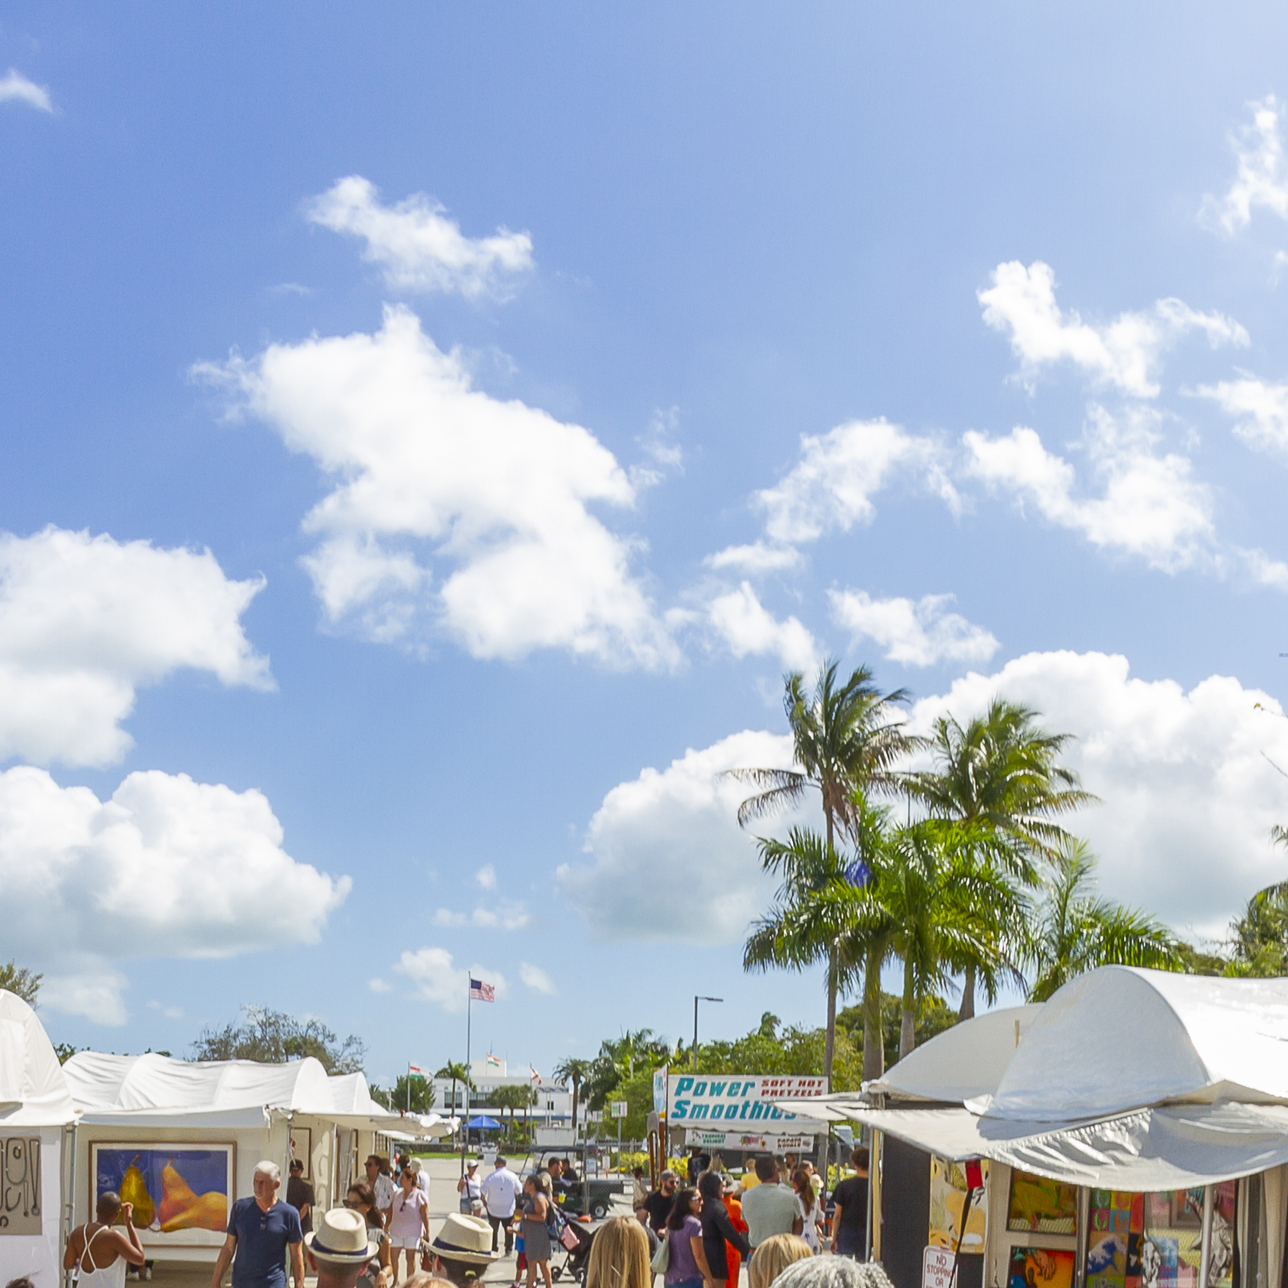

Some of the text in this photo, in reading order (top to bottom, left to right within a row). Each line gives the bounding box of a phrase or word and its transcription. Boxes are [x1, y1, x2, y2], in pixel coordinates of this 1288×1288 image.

[674, 1077, 755, 1097] Power
[762, 1079, 824, 1088] SOFT HOT
[936, 1255, 947, 1267] NO
[935, 1276, 944, 1287] OR
